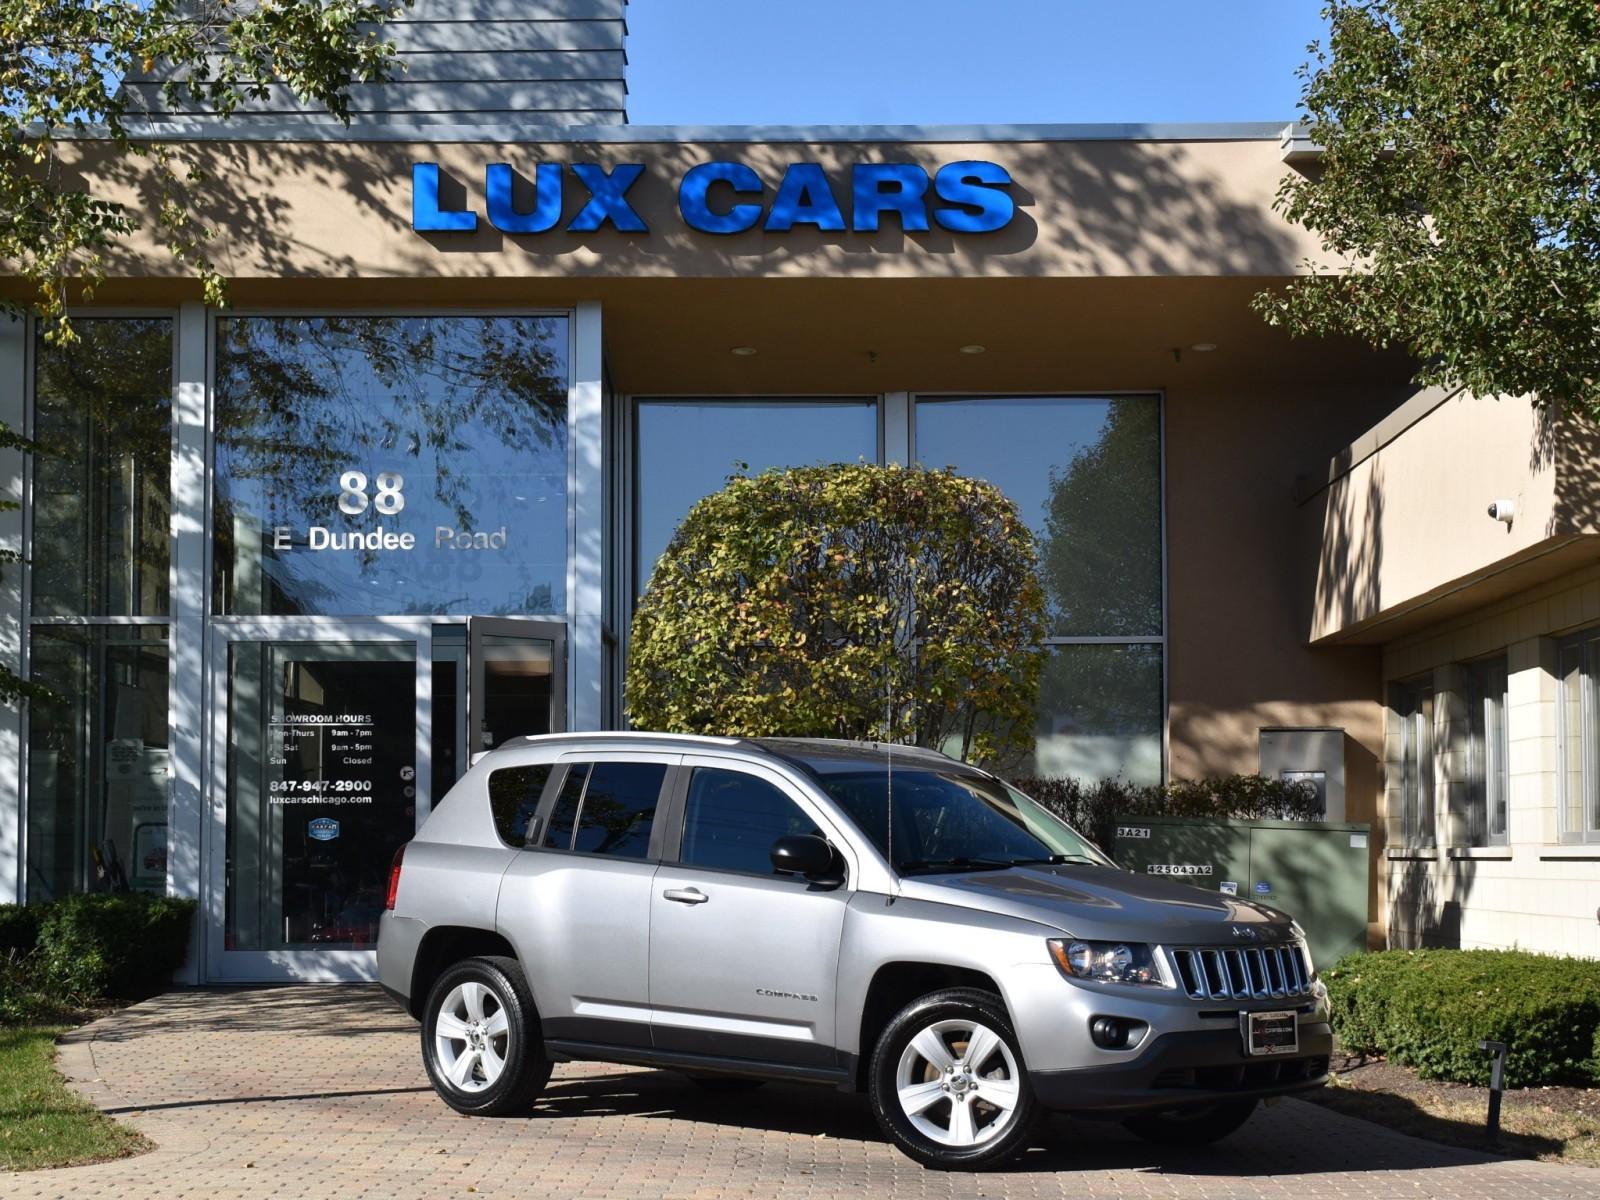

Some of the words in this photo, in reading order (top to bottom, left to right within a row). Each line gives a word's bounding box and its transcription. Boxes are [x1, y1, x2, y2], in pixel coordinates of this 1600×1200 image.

[412, 162, 649, 233] LUX
[678, 160, 1014, 234] CARS
[338, 471, 405, 515] 88
[273, 527, 293, 550] E
[309, 526, 416, 550] Dundee
[435, 526, 507, 550] Road
[271, 714, 333, 723] SOWROOM
[335, 714, 372, 723] HOURS
[331, 729, 349, 737] 9am
[355, 729, 372, 739] 7pm
[355, 744, 372, 753] 5pm
[269, 757, 287, 765] Sun
[269, 780, 372, 791] 847-947-2900
[269, 795, 372, 805] luxcarschicago.com
[1118, 827, 1149, 838] 3A21
[1147, 865, 1212, 875] 425043A2
[755, 988, 818, 1001] COMPASS
